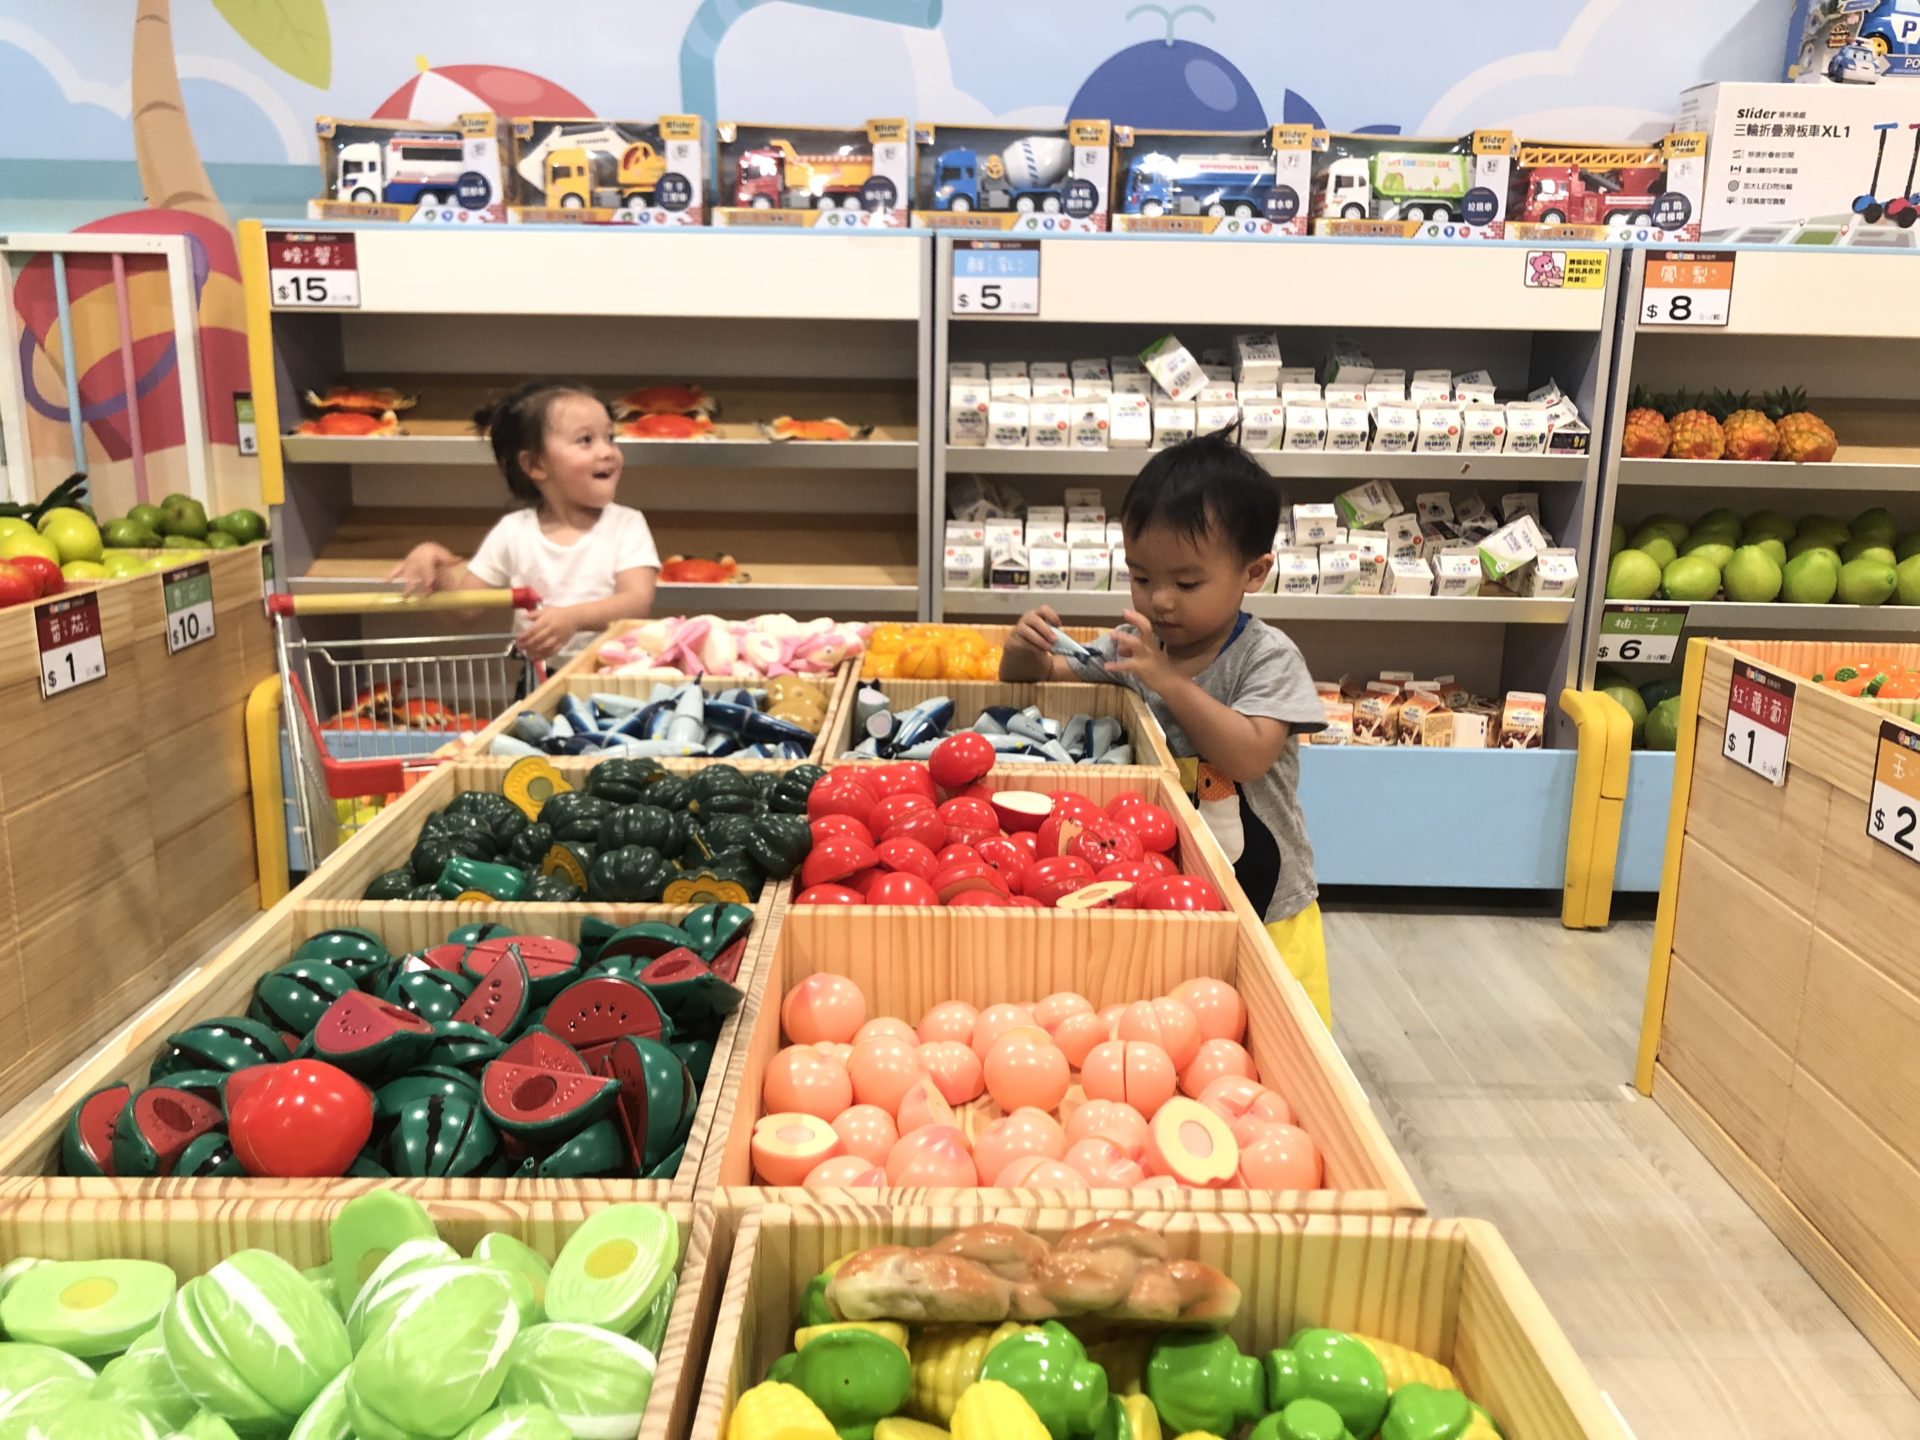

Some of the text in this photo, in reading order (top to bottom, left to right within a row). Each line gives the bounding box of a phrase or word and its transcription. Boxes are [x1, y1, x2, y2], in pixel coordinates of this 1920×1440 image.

[1736, 108, 1777, 119] Slider
[1478, 135, 1507, 144] Slider
[1670, 138, 1700, 148] Slider
